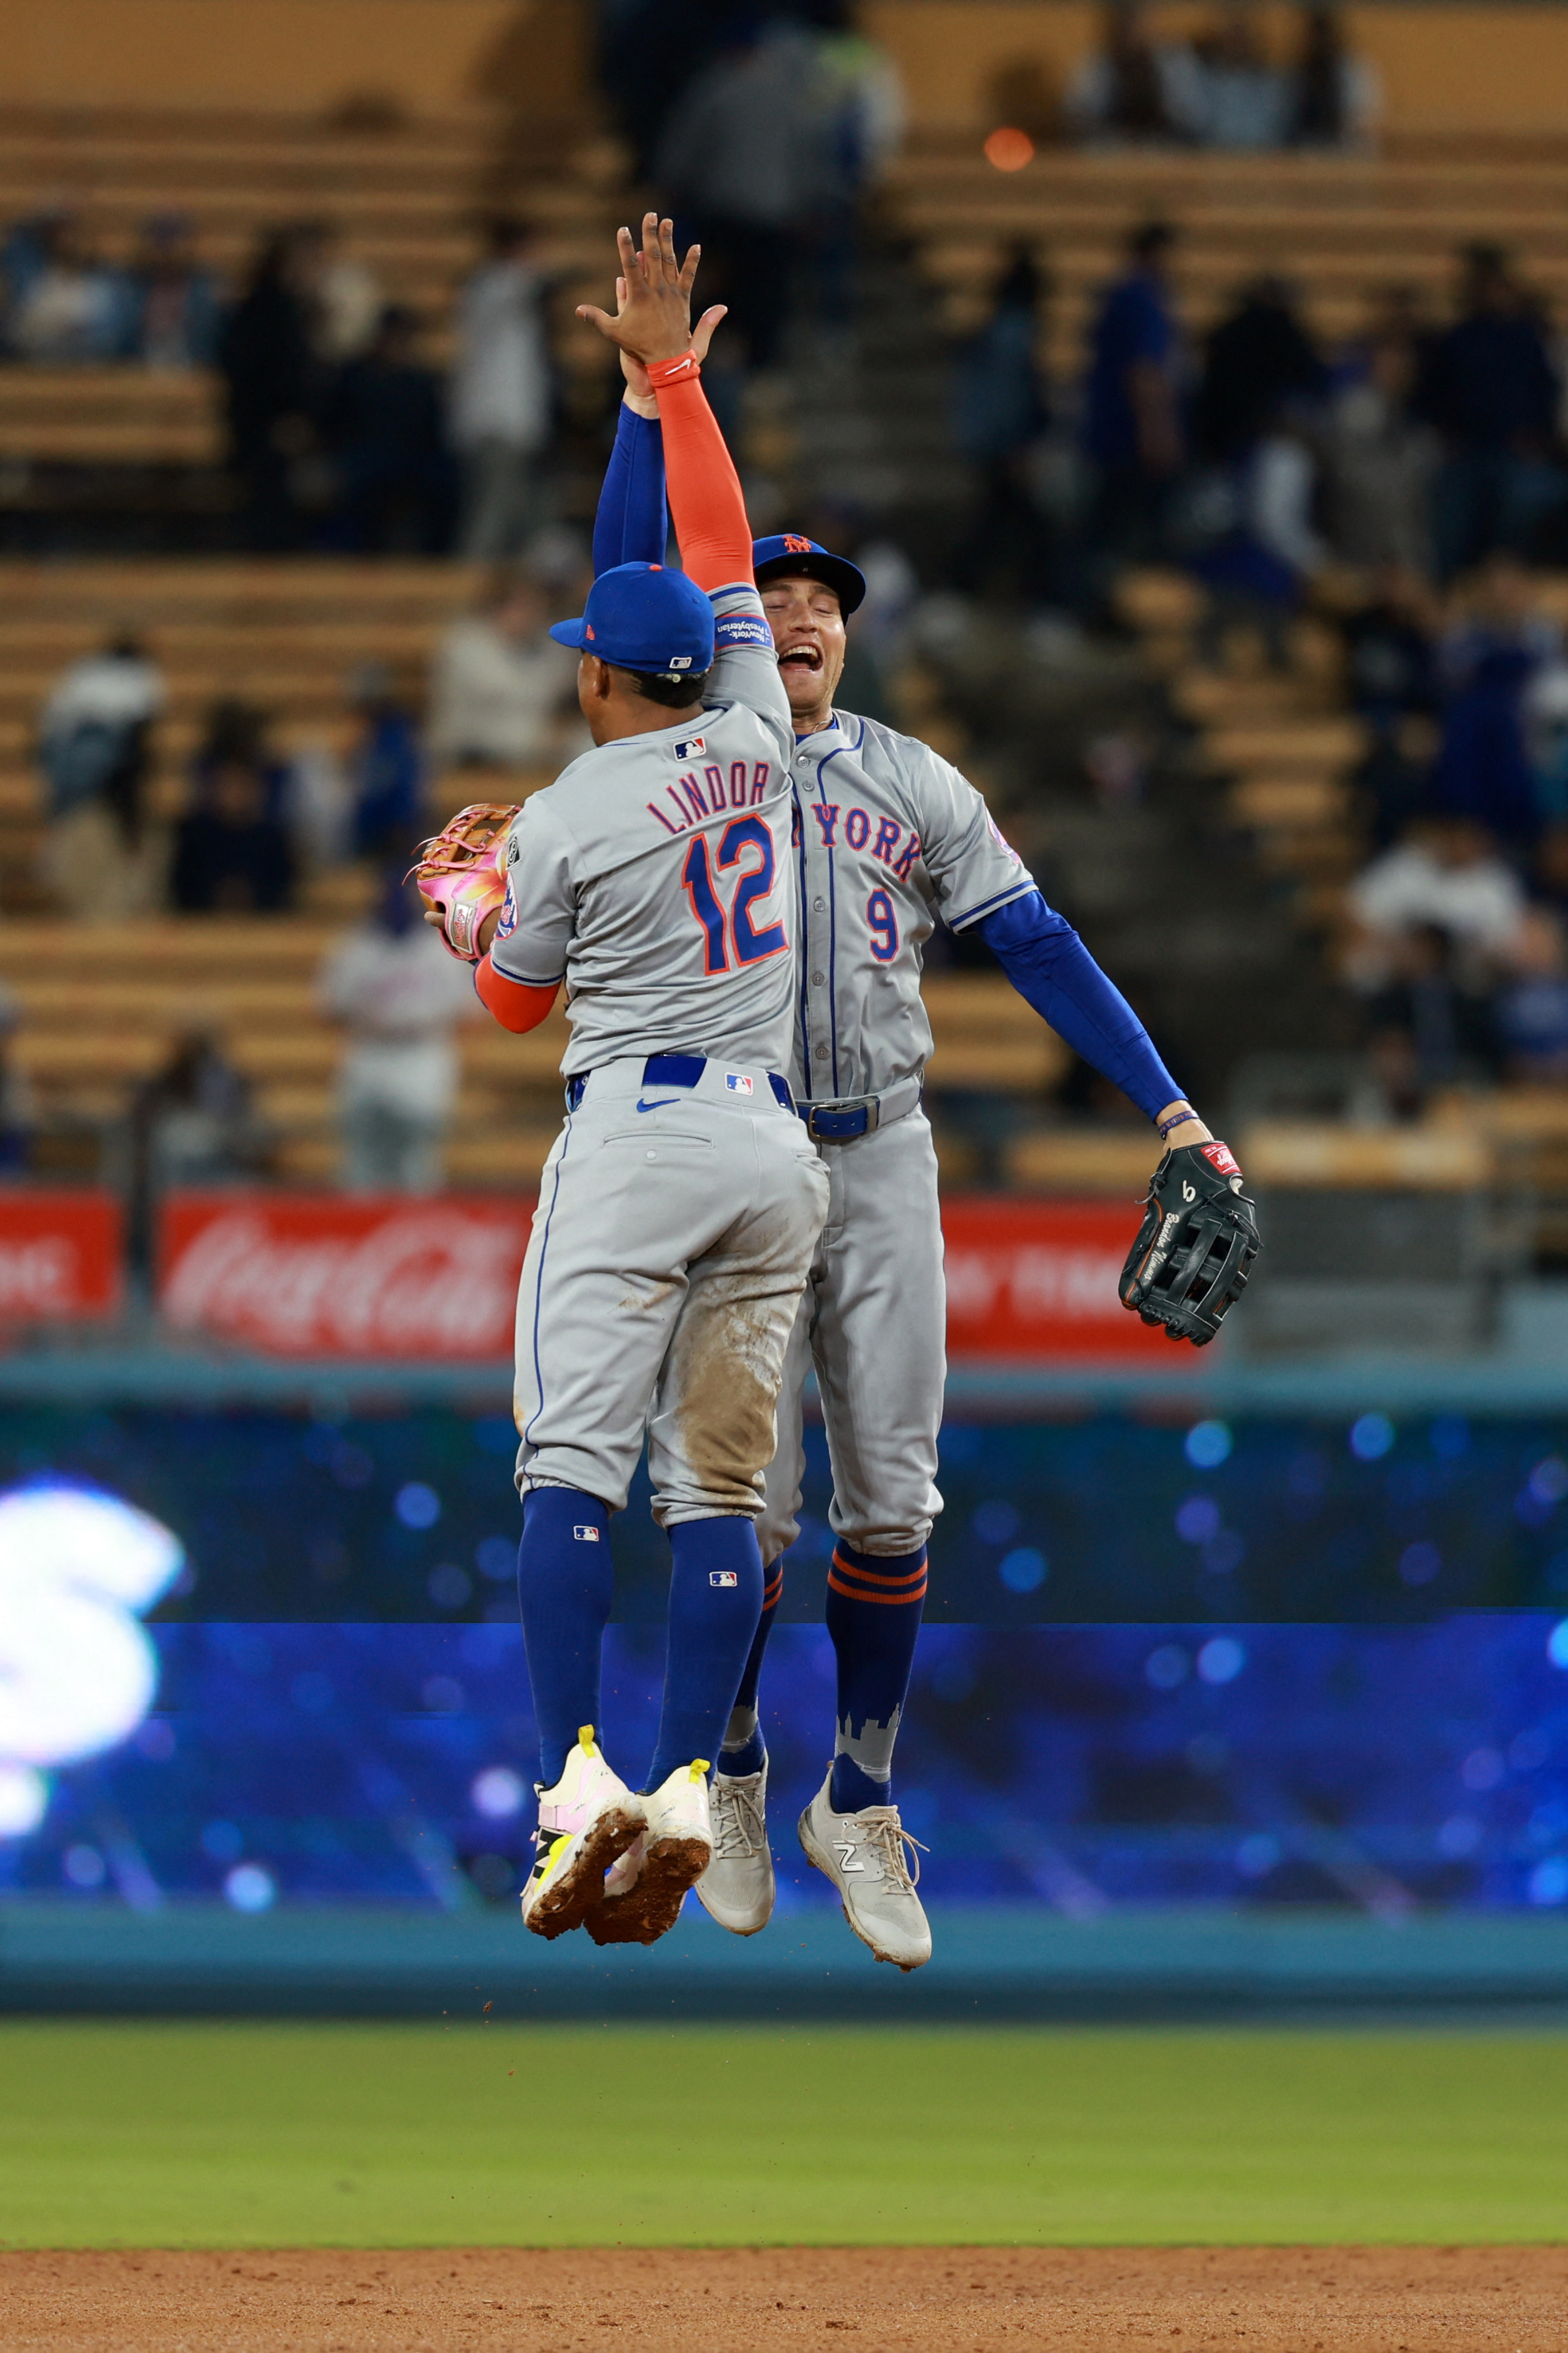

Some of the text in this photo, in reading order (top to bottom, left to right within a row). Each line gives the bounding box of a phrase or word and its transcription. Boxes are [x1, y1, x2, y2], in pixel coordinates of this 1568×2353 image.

[717, 621, 765, 634] Presbyterian
[646, 761, 769, 835] LINDOR
[810, 803, 922, 883] YORK
[681, 812, 790, 977] 12
[866, 888, 899, 962] 9
[1144, 1212, 1180, 1281] Brandon Nimmo
